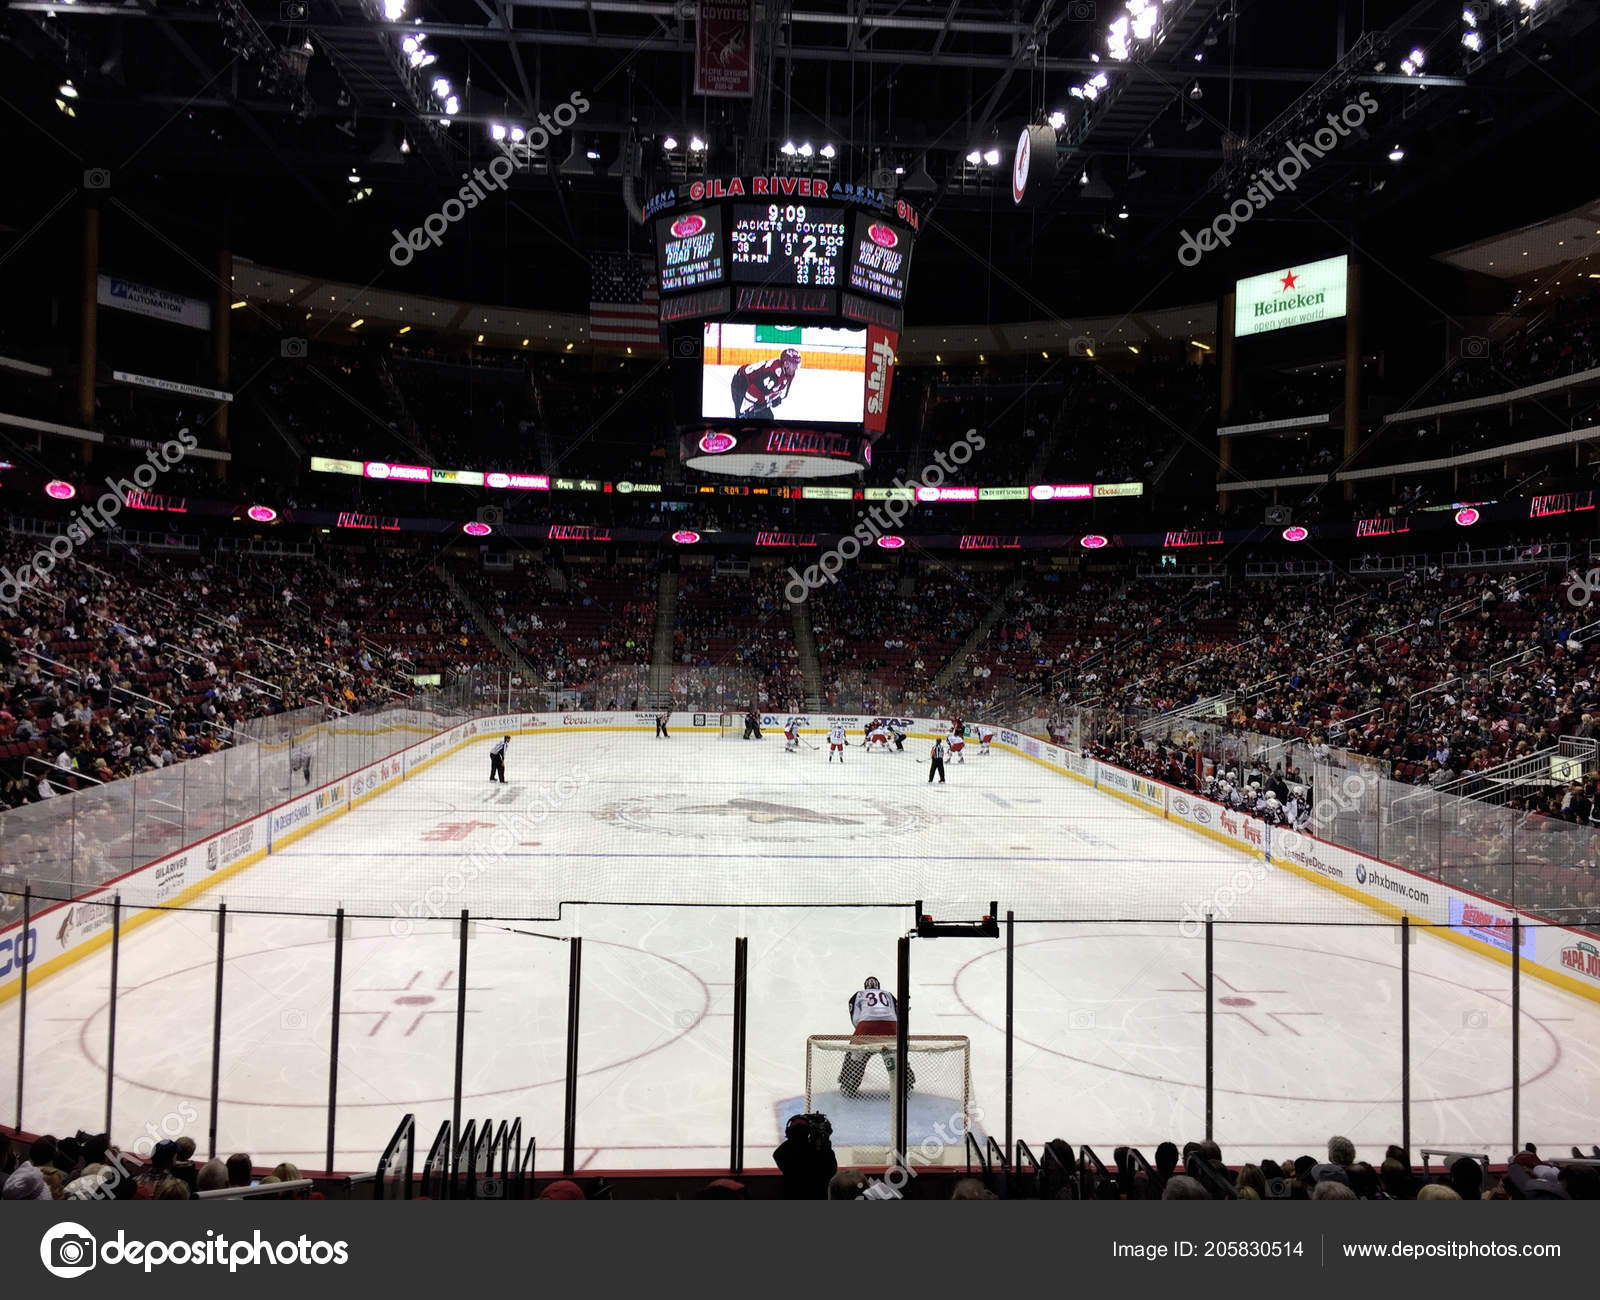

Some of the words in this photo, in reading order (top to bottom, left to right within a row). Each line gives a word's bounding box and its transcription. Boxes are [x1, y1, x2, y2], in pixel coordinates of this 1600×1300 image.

[690, 177, 745, 200] GILA
[752, 176, 829, 199] RIVER
[832, 182, 885, 202] ARENA
[768, 204, 806, 222] 9:09
[897, 199, 919, 231] GILA
[737, 220, 783, 231] JACKETS
[796, 223, 845, 234] COYOTES
[762, 231, 772, 255] 1
[780, 233, 799, 243] PER
[802, 235, 817, 258] 2
[784, 243, 793, 256] 3
[751, 254, 769, 263] PEN
[127, 294, 182, 312] AUTOMATION
[1254, 292, 1325, 317] Heineken
[1254, 320, 1276, 333] open
[1277, 315, 1298, 329] your
[1299, 308, 1325, 322] world
[155, 856, 188, 880] GILARIVER
[1368, 870, 1430, 905] phxbmw.com
[1562, 949, 1585, 972] PAPA
[865, 991, 890, 1007] 30
